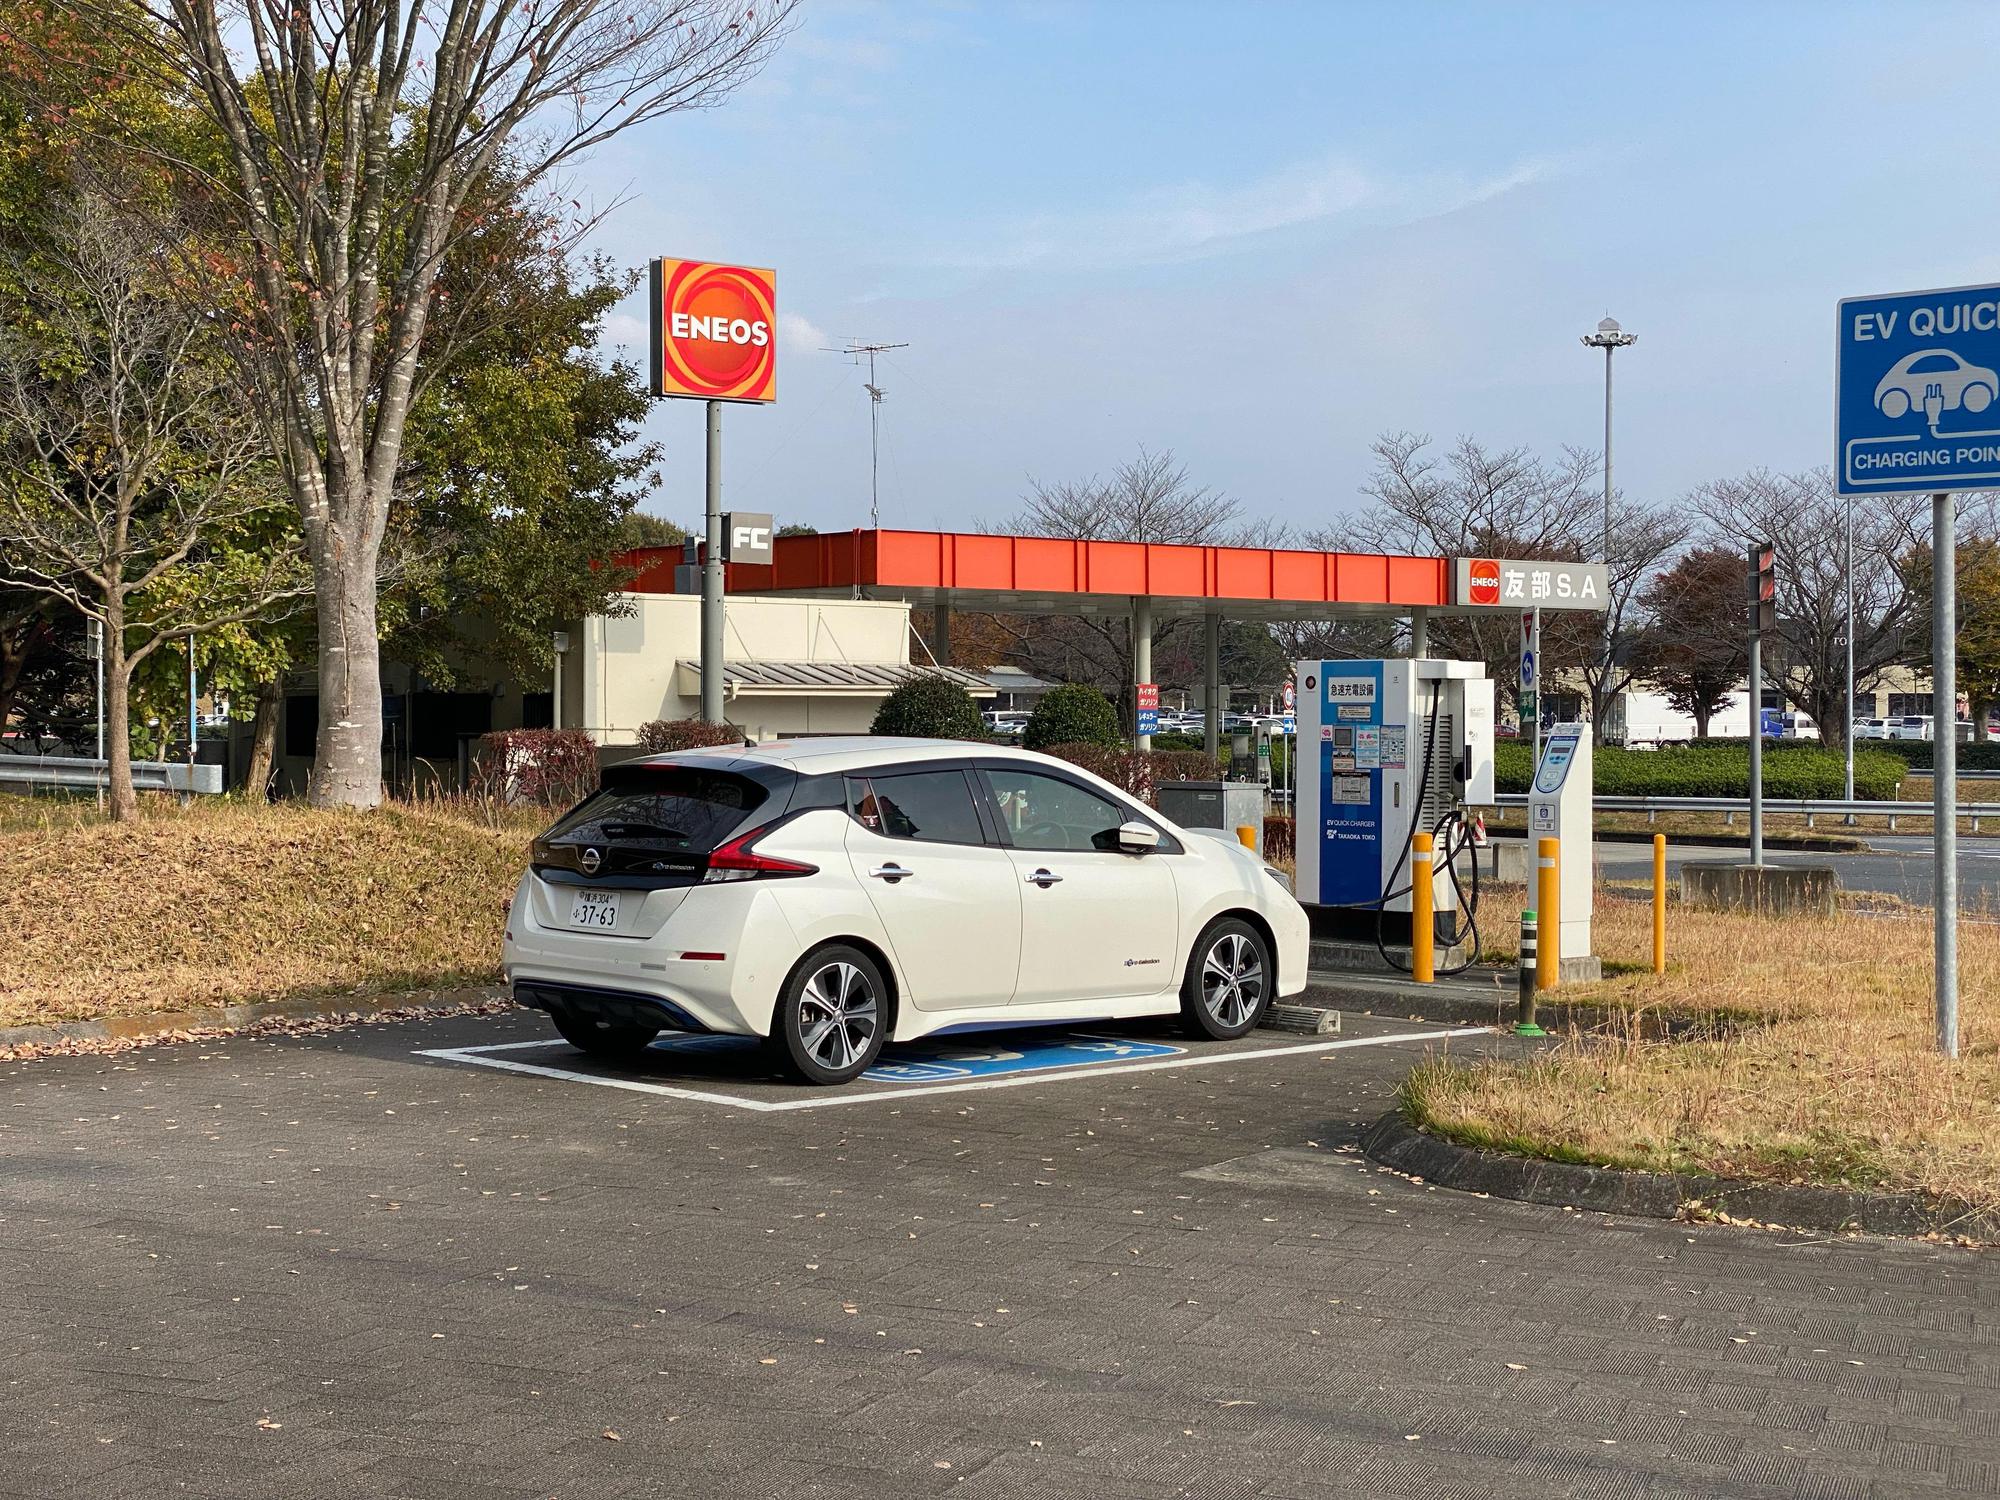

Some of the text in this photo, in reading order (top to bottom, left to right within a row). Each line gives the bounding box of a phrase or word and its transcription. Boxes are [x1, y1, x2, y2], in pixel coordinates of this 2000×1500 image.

[1854, 302, 2000, 341] EV QUIC
[671, 312, 769, 347] ENEOS
[1854, 450, 1951, 470] CHARGING
[733, 526, 771, 550] FC
[1471, 577, 1499, 588] ENEOS
[1139, 688, 1157, 696] ハイオク
[1331, 683, 1374, 697] 急速充電設備
[1139, 712, 1157, 721] レギュラー
[1139, 723, 1158, 731] ガソリン
[1350, 820, 1376, 828] CHARGER
[580, 904, 616, 926] 37-63
